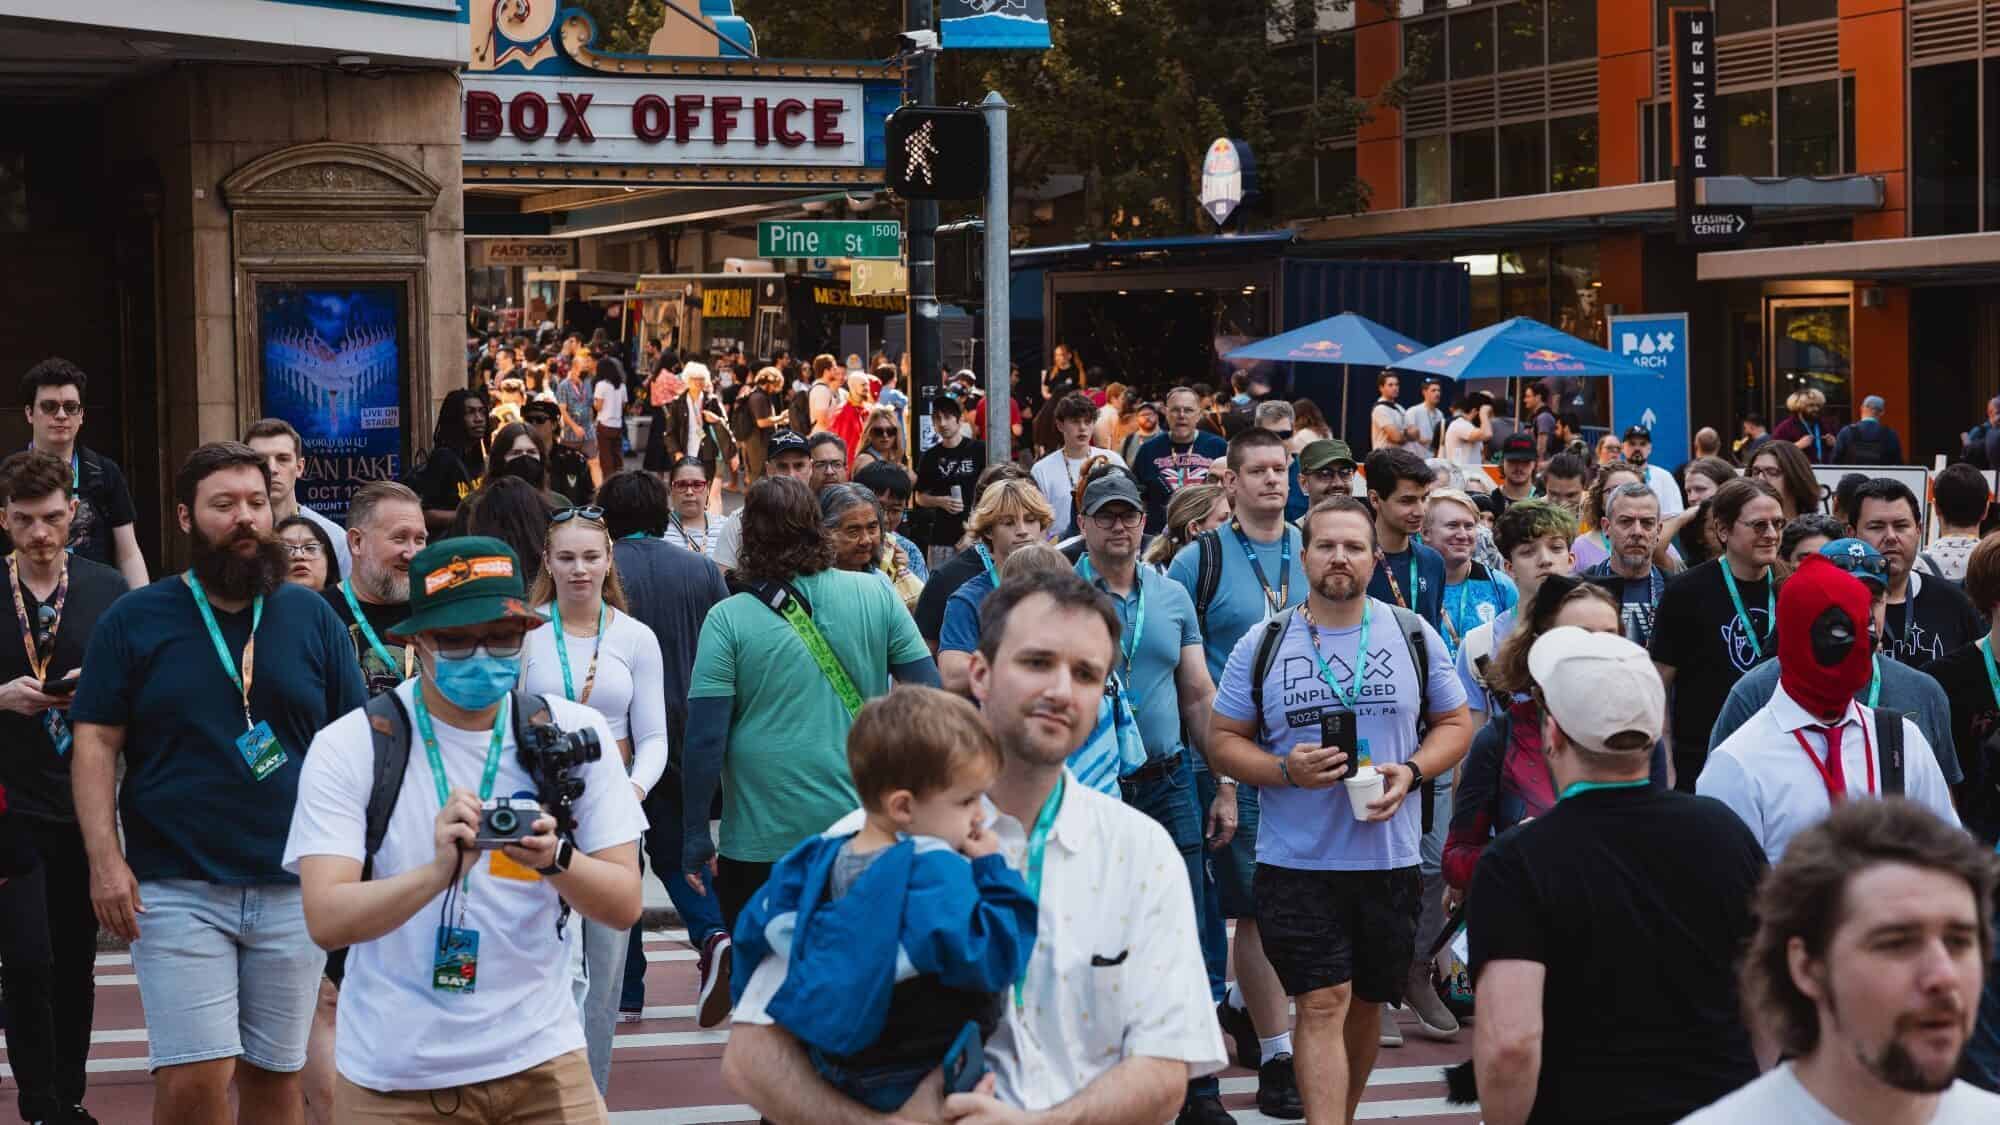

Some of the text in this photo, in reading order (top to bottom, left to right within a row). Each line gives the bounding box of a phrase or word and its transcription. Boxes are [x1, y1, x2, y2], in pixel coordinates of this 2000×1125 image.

[1691, 21, 1707, 169] PREMIERE
[467, 90, 845, 148] BOX OFFICE
[1692, 214, 1735, 225] LEASING
[1694, 224, 1732, 235] CENTER
[770, 225, 897, 252] Pine St 1500
[1622, 331, 1675, 356] PAX
[362, 408, 398, 417] LIVE ON
[303, 437, 335, 448] WORLD
[346, 453, 399, 484] LAKE
[307, 485, 340, 499] OCT
[1283, 648, 1394, 690] PAX
[1283, 684, 1396, 706] UNPLUGGED
[1289, 711, 1320, 724] 2023
